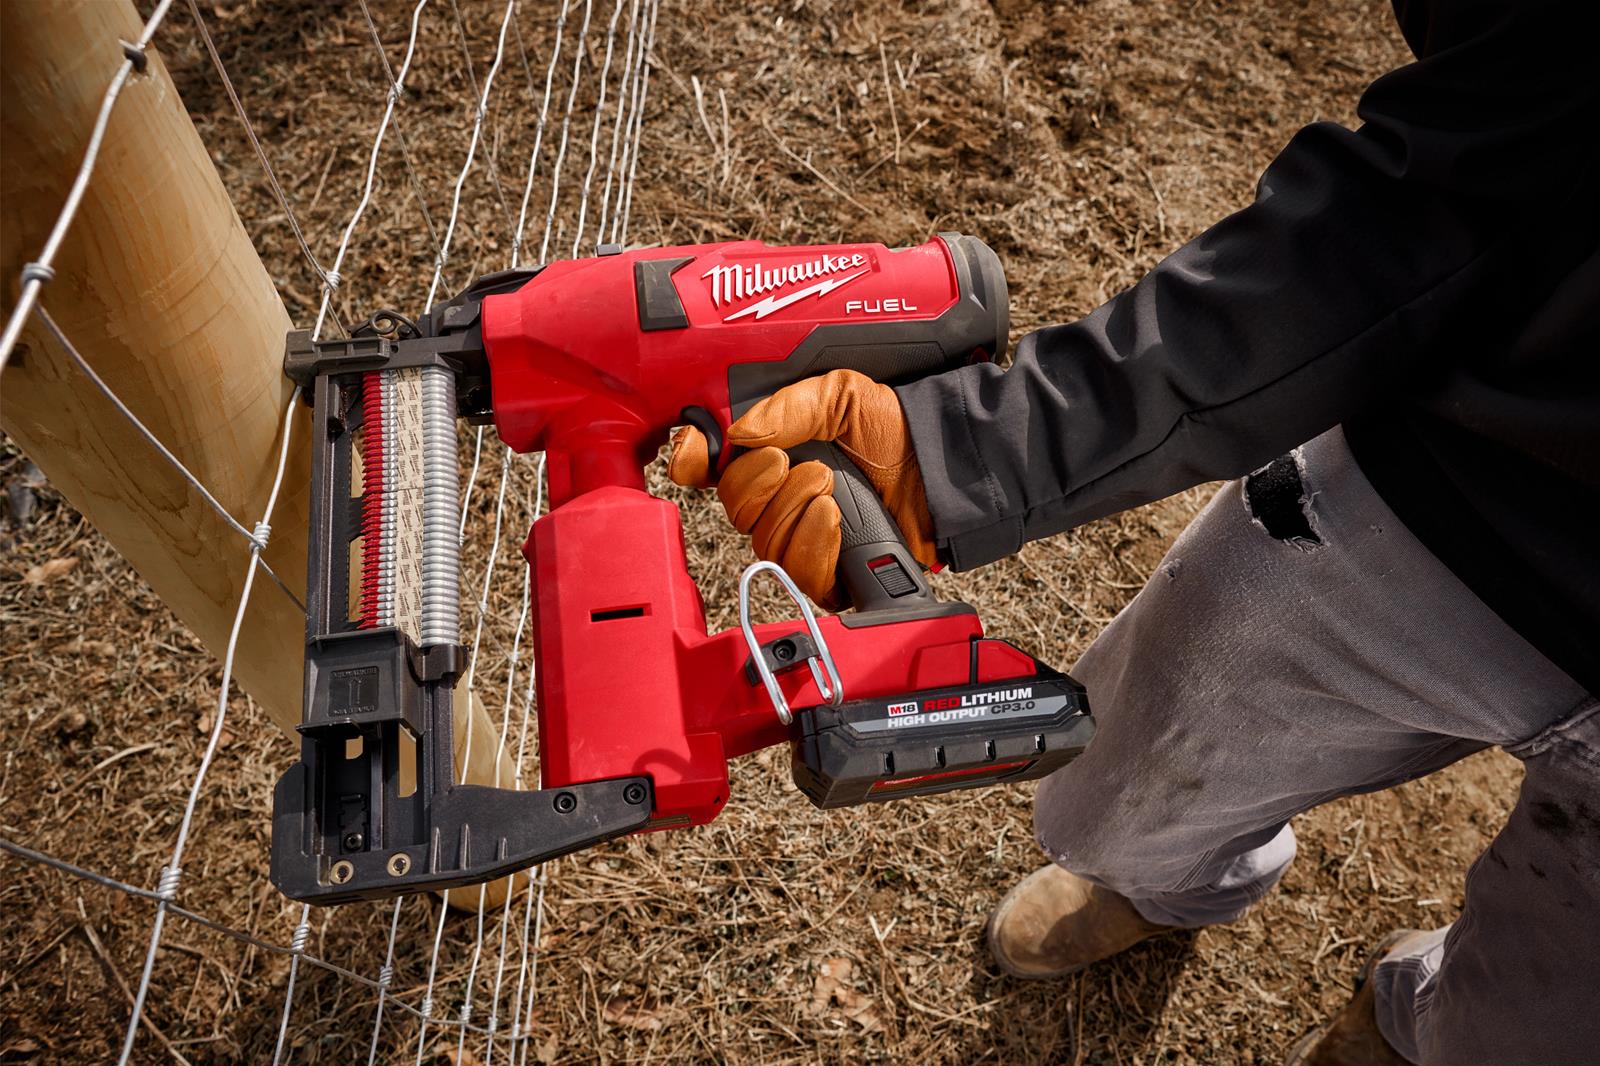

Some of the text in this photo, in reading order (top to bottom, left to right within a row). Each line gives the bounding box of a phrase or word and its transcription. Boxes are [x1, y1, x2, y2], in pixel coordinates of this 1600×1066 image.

[701, 253, 867, 307] Milwaukee
[846, 298, 918, 314] FUEL
[888, 701, 1036, 729] HIGH OUTPUT CP3.0
[890, 687, 1032, 715] M18 REDLITHIUM
